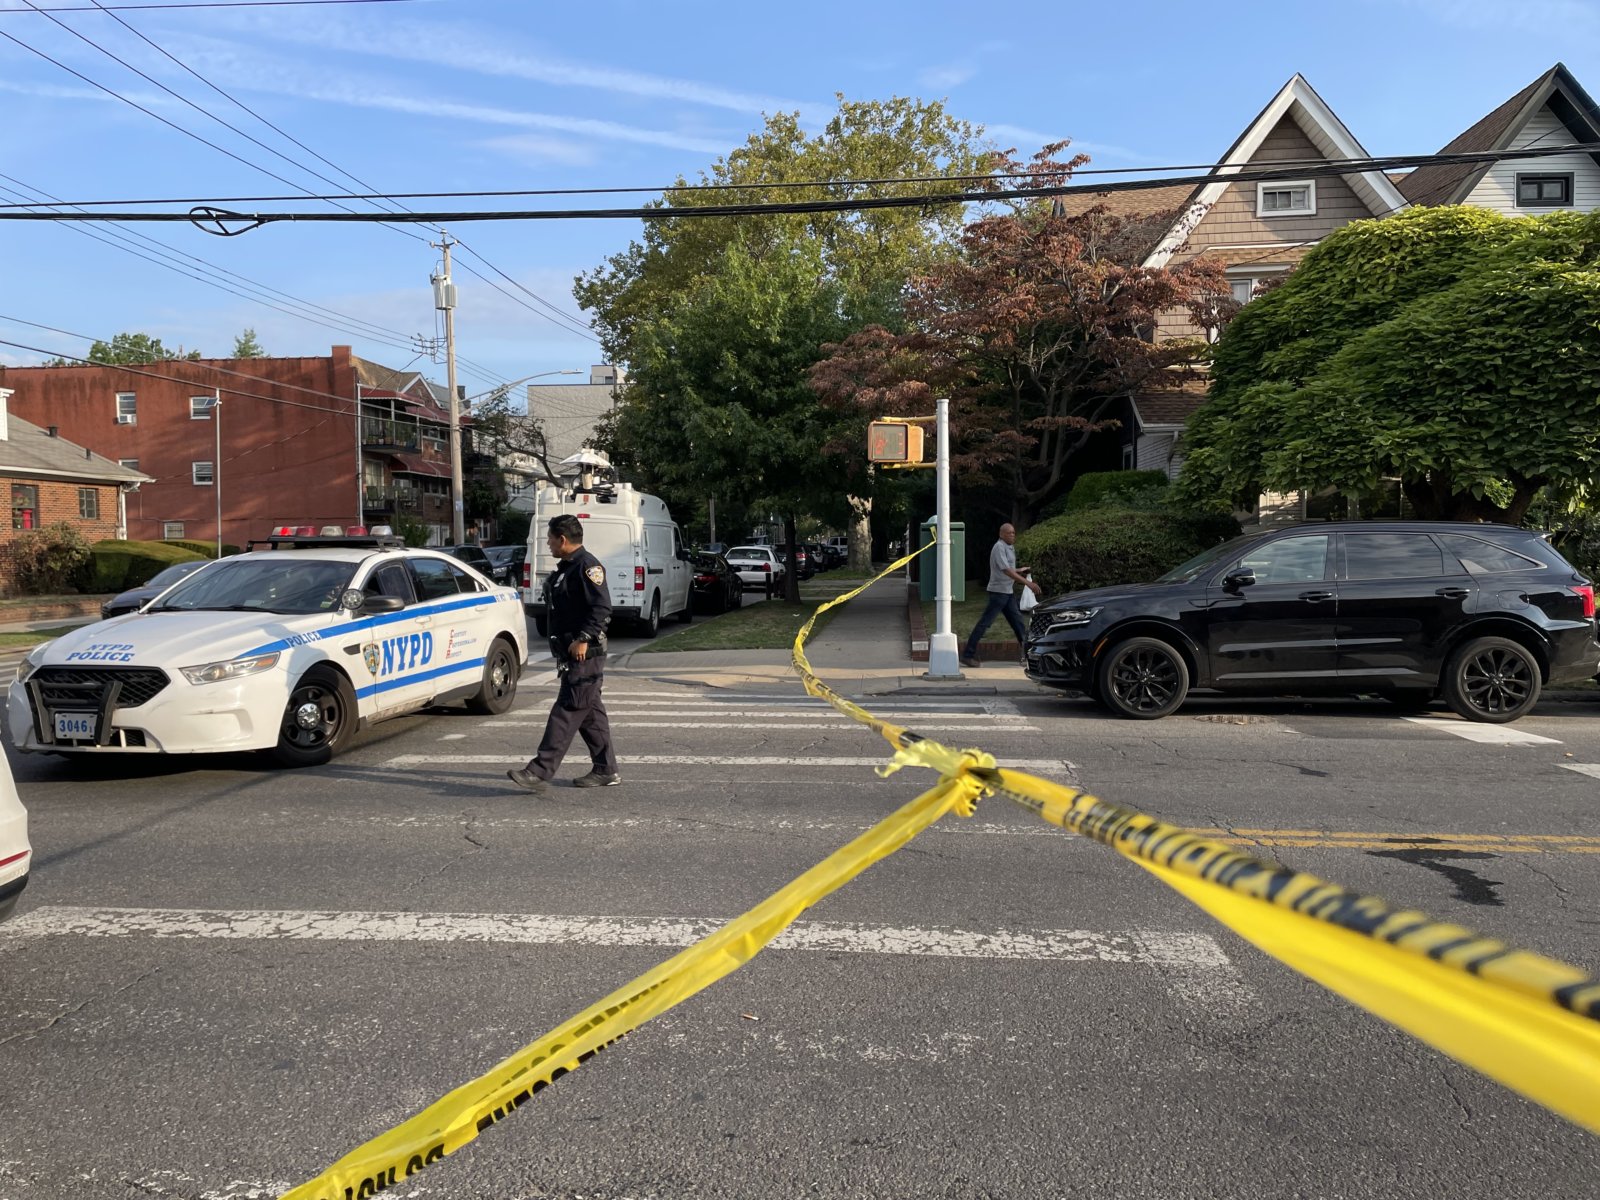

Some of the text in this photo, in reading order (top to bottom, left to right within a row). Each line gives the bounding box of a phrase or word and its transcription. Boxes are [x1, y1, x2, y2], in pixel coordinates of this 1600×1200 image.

[288, 631, 321, 647] POLICE
[65, 652, 136, 662] POLICE
[381, 631, 433, 676] NYPD
[59, 720, 88, 733] 3046
